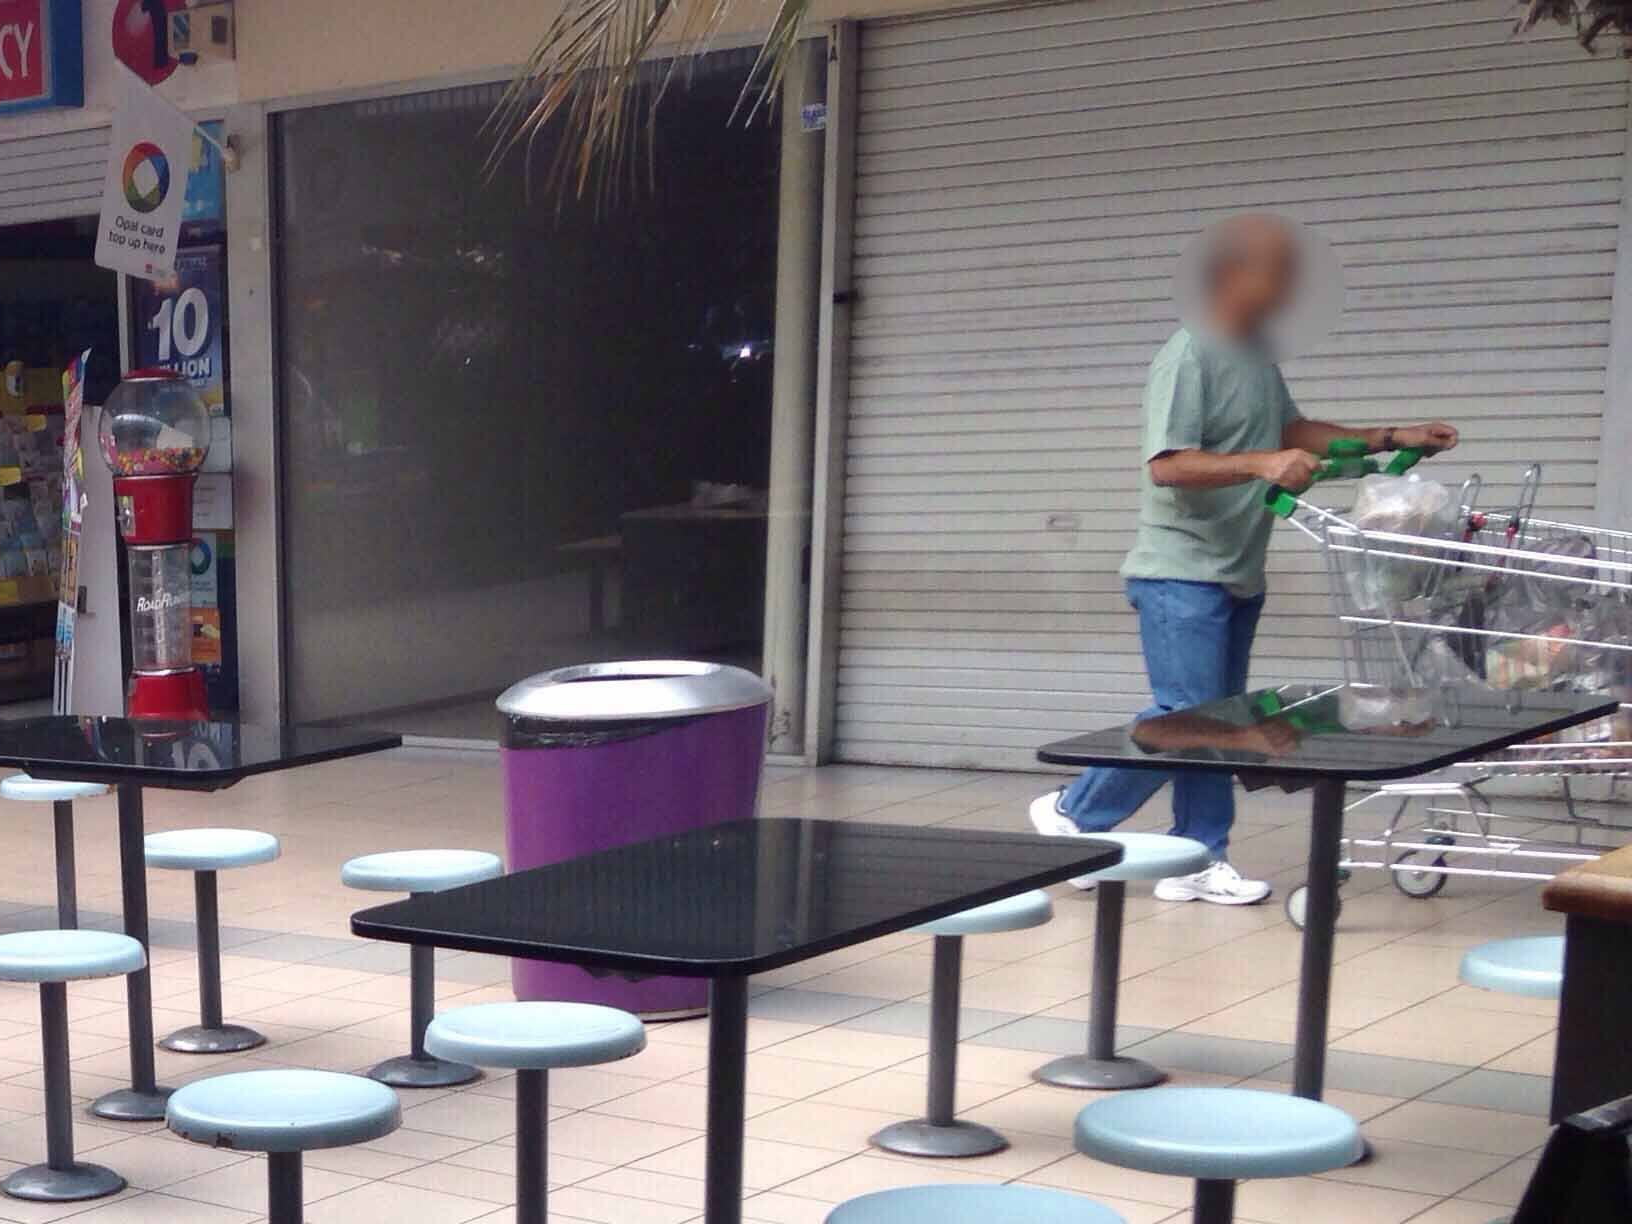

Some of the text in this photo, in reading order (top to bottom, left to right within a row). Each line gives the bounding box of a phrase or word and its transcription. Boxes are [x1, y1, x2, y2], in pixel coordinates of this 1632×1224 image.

[115, 215, 164, 238] Opal card
[108, 231, 166, 254] top up here
